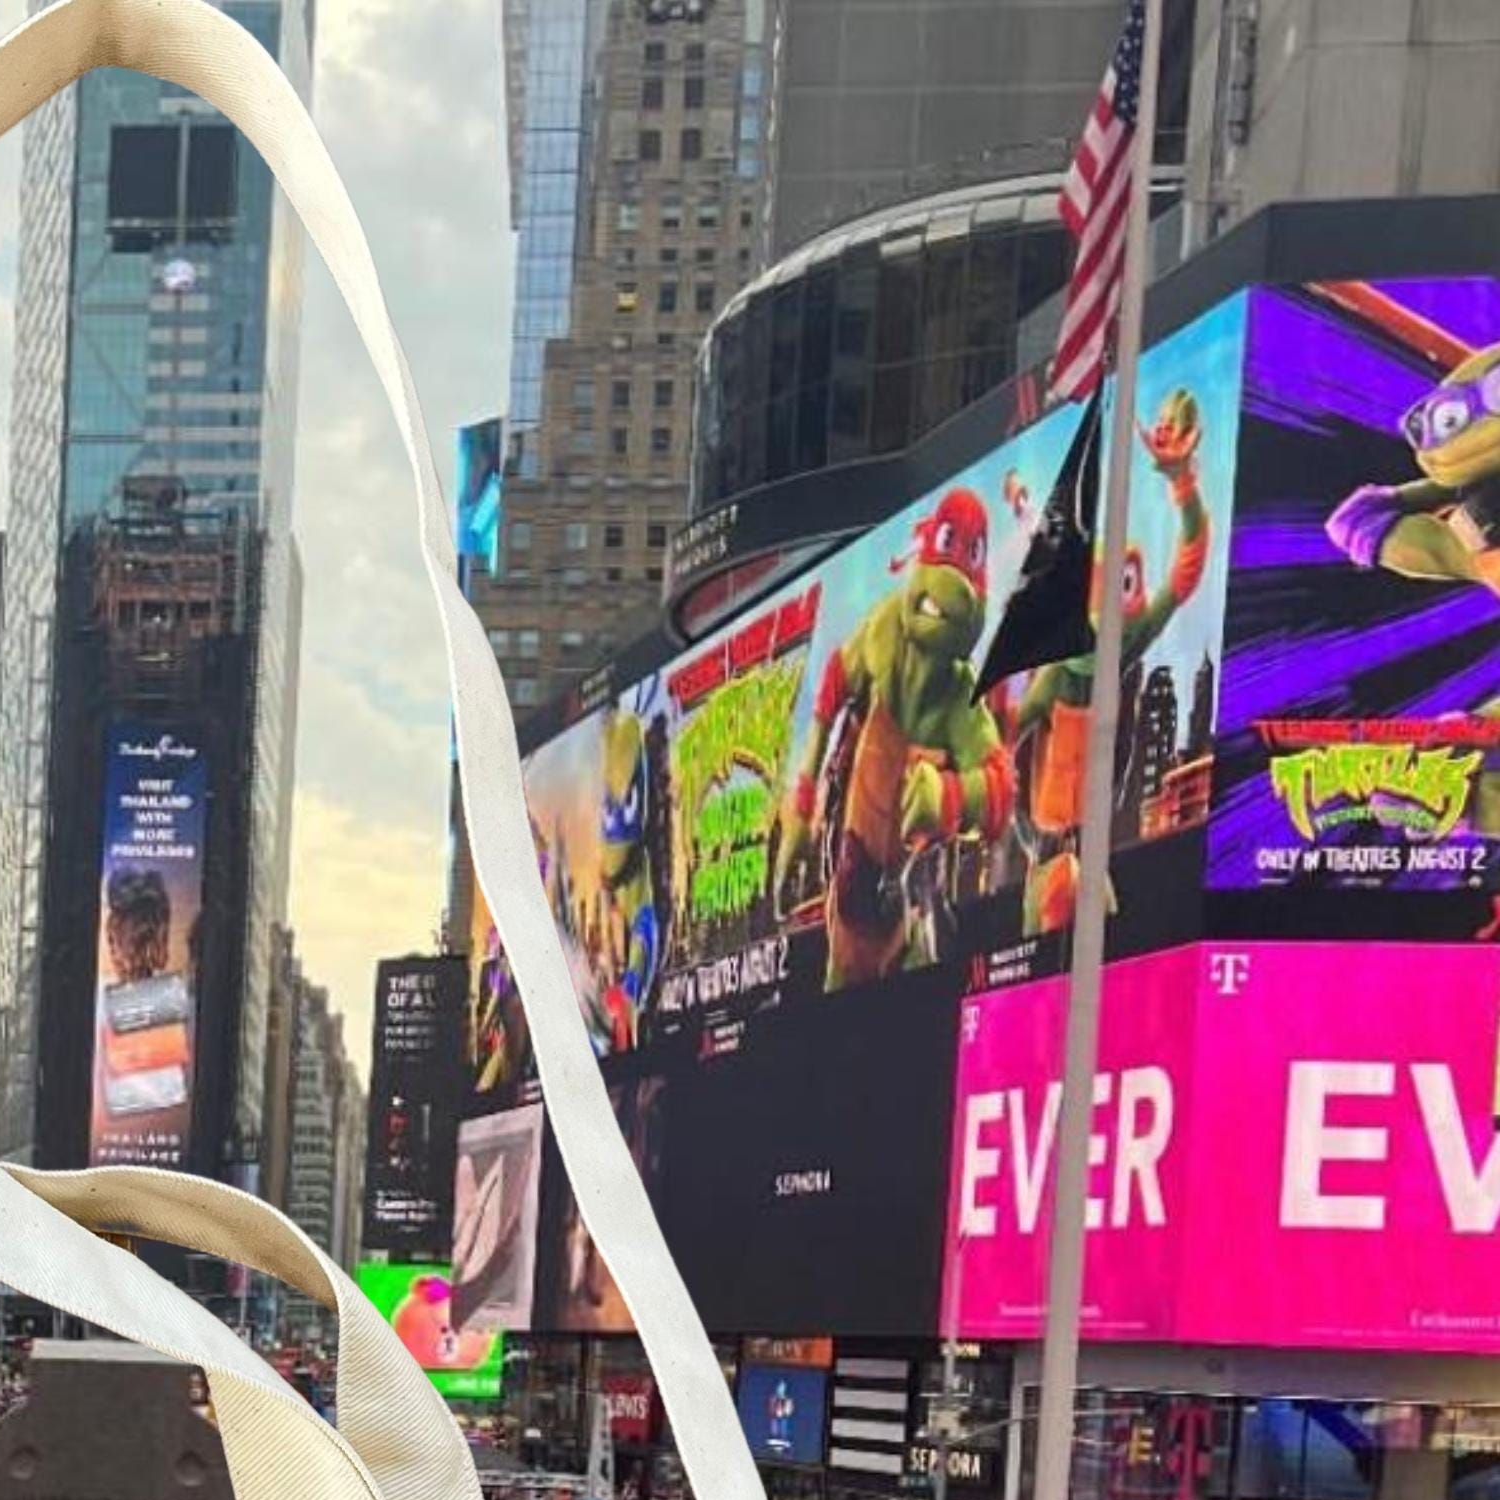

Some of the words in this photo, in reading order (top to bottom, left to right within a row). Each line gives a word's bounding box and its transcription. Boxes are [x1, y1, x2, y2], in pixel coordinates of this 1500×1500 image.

[1256, 847, 1300, 871] ONLY
[1302, 848, 1321, 872] IN
[1407, 846, 1466, 872] AUGUST
[1470, 847, 1487, 870] 2
[957, 1064, 1174, 1239] EVER
[911, 1446, 981, 1480] SEPORA
